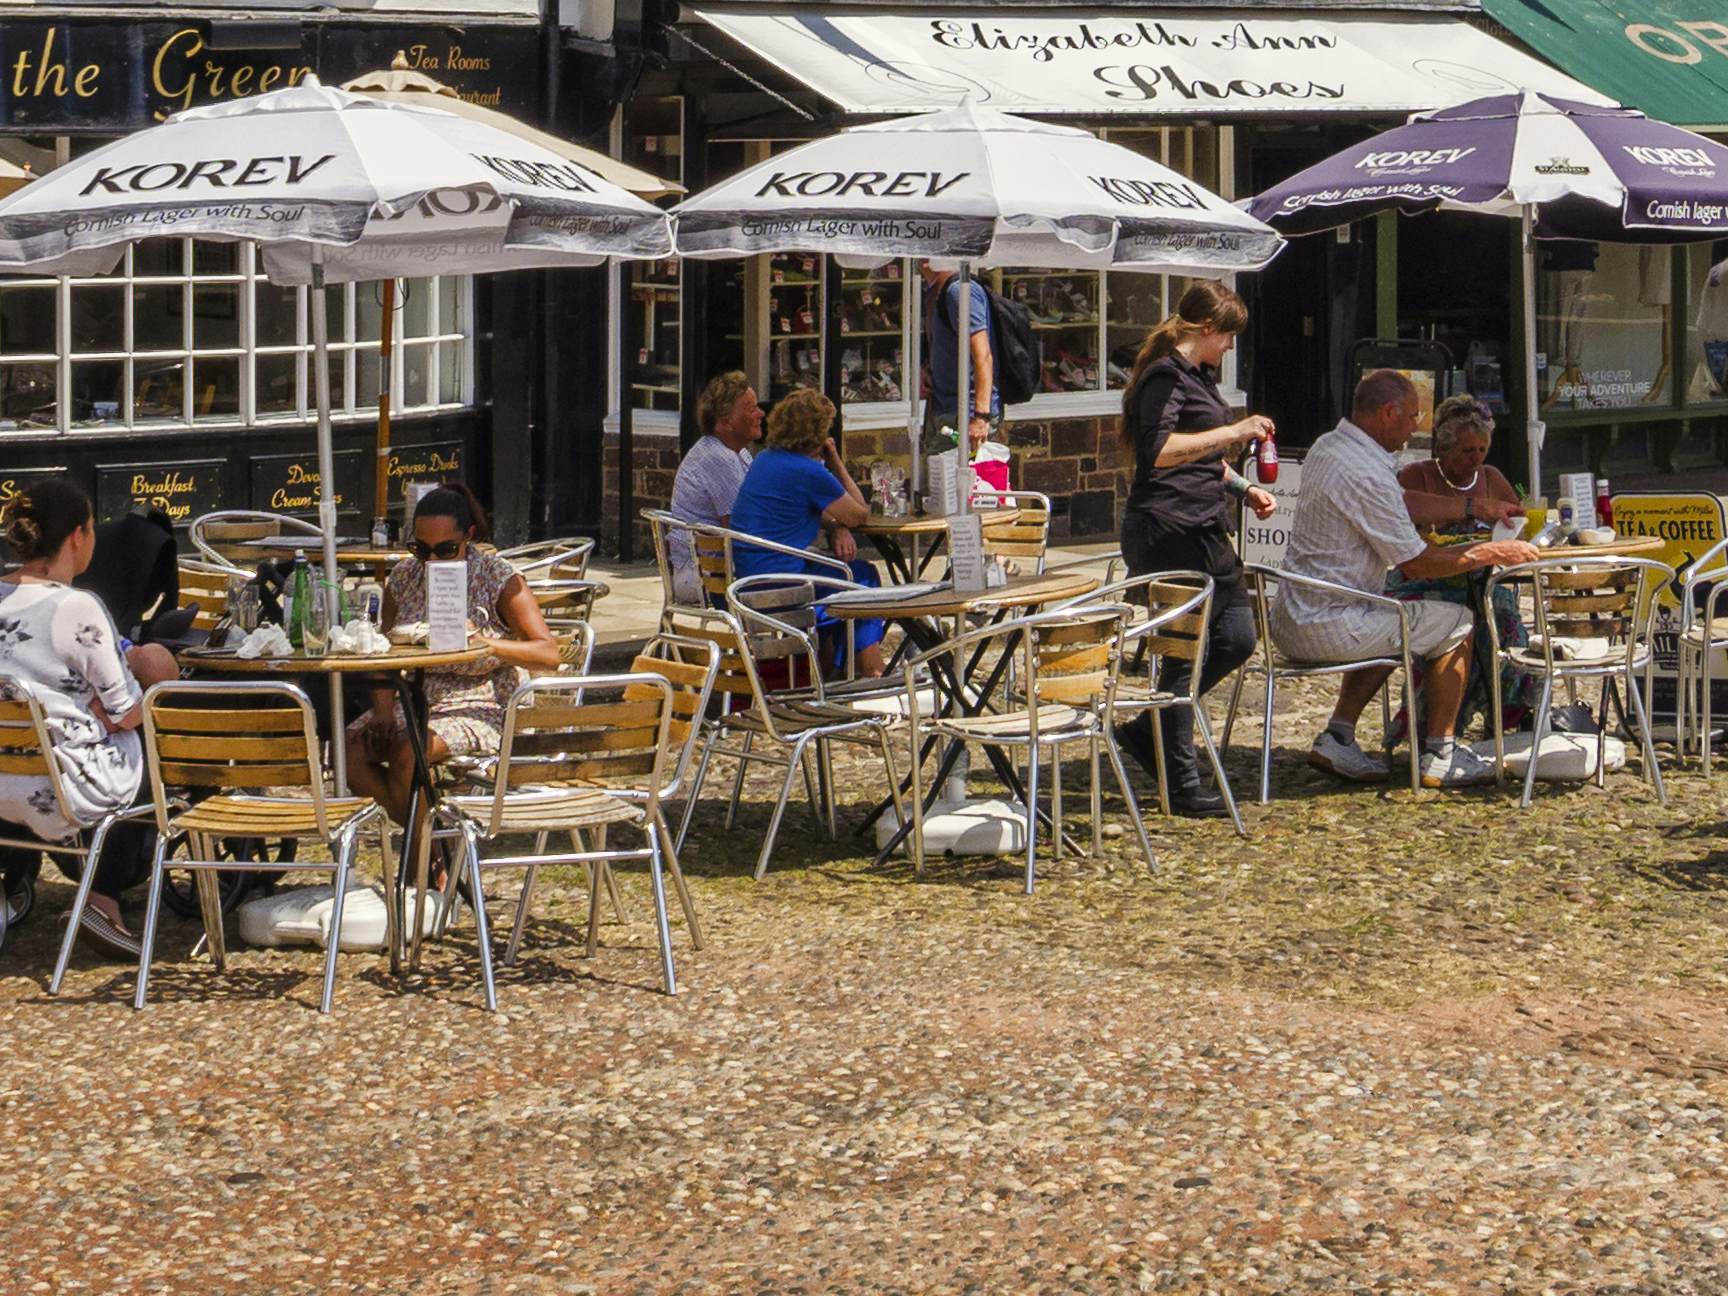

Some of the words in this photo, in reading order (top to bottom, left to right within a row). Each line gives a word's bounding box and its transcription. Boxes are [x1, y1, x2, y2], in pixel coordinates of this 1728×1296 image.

[931, 18, 1198, 63] Elizabeth
[1210, 21, 1339, 53] Ann
[408, 44, 440, 70] Tea
[447, 45, 491, 70] Rooms
[12, 26, 101, 98] the
[152, 27, 313, 122] Green
[1092, 63, 1345, 102] Shoes
[1355, 146, 1477, 169] KOREV
[1622, 145, 1716, 168] KOREV
[78, 154, 336, 198] KOREV
[468, 152, 600, 194] KOREV
[753, 170, 972, 198] KOREV
[1087, 175, 1211, 210] KOREV
[64, 211, 136, 238] Cornish
[142, 207, 200, 225] Lager
[206, 203, 252, 219] with
[255, 204, 306, 223] Soul
[1646, 199, 1692, 219] Cornish
[1693, 200, 1722, 225] lager
[806, 217, 864, 241] Lager
[863, 218, 902, 239] with
[904, 220, 942, 241] Soul
[1217, 232, 1241, 250] Soul
[1558, 384, 1588, 398] YOUR
[1589, 381, 1651, 398] ADVENTURE
[287, 464, 321, 486] Devo
[387, 456, 427, 477] Espresso
[130, 471, 195, 495] Breakfast
[271, 487, 312, 508] Cream
[1247, 527, 1291, 546] SHO
[1616, 520, 1646, 538] TEA
[1658, 520, 1717, 542] COFFEE
